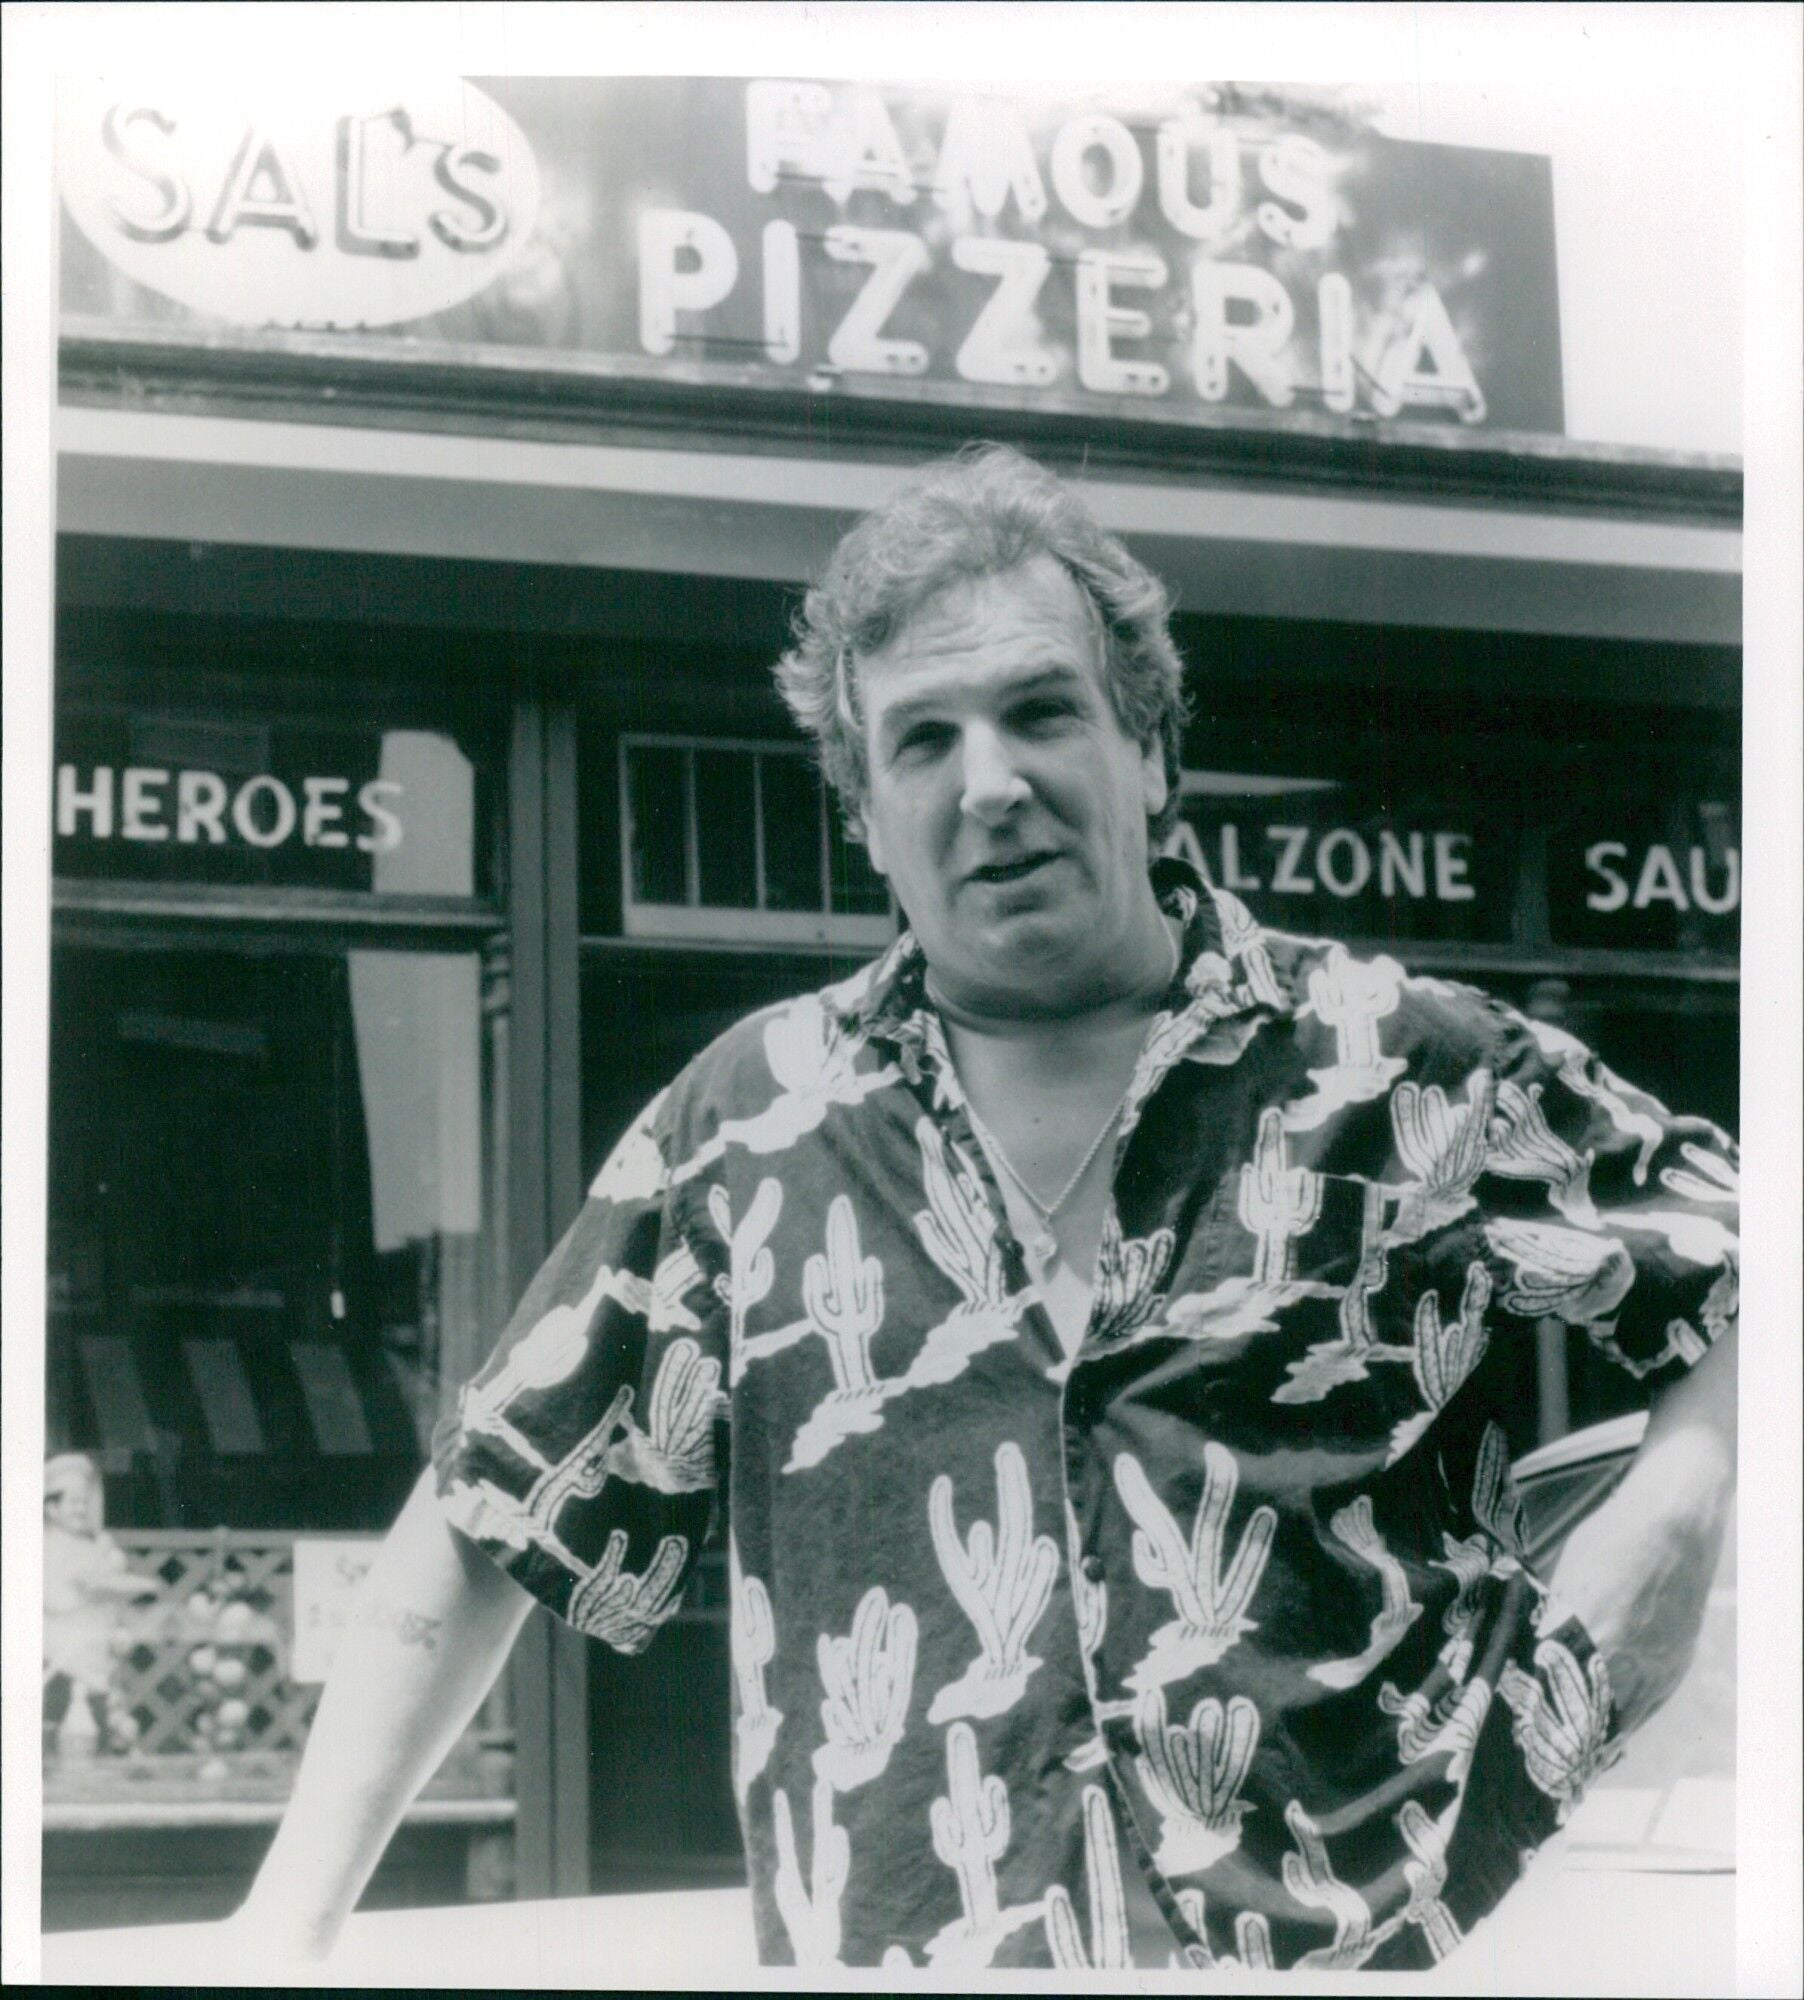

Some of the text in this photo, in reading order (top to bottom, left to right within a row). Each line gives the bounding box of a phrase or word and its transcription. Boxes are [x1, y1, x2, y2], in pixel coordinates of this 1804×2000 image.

[101, 98, 508, 260] SAL'S
[746, 80, 1339, 248] FAMOUS
[637, 208, 1487, 425] PIZZERIA
[57, 763, 403, 852] HEROES
[1163, 820, 1475, 900] ALZONE
[1583, 840, 1741, 915] SAU
